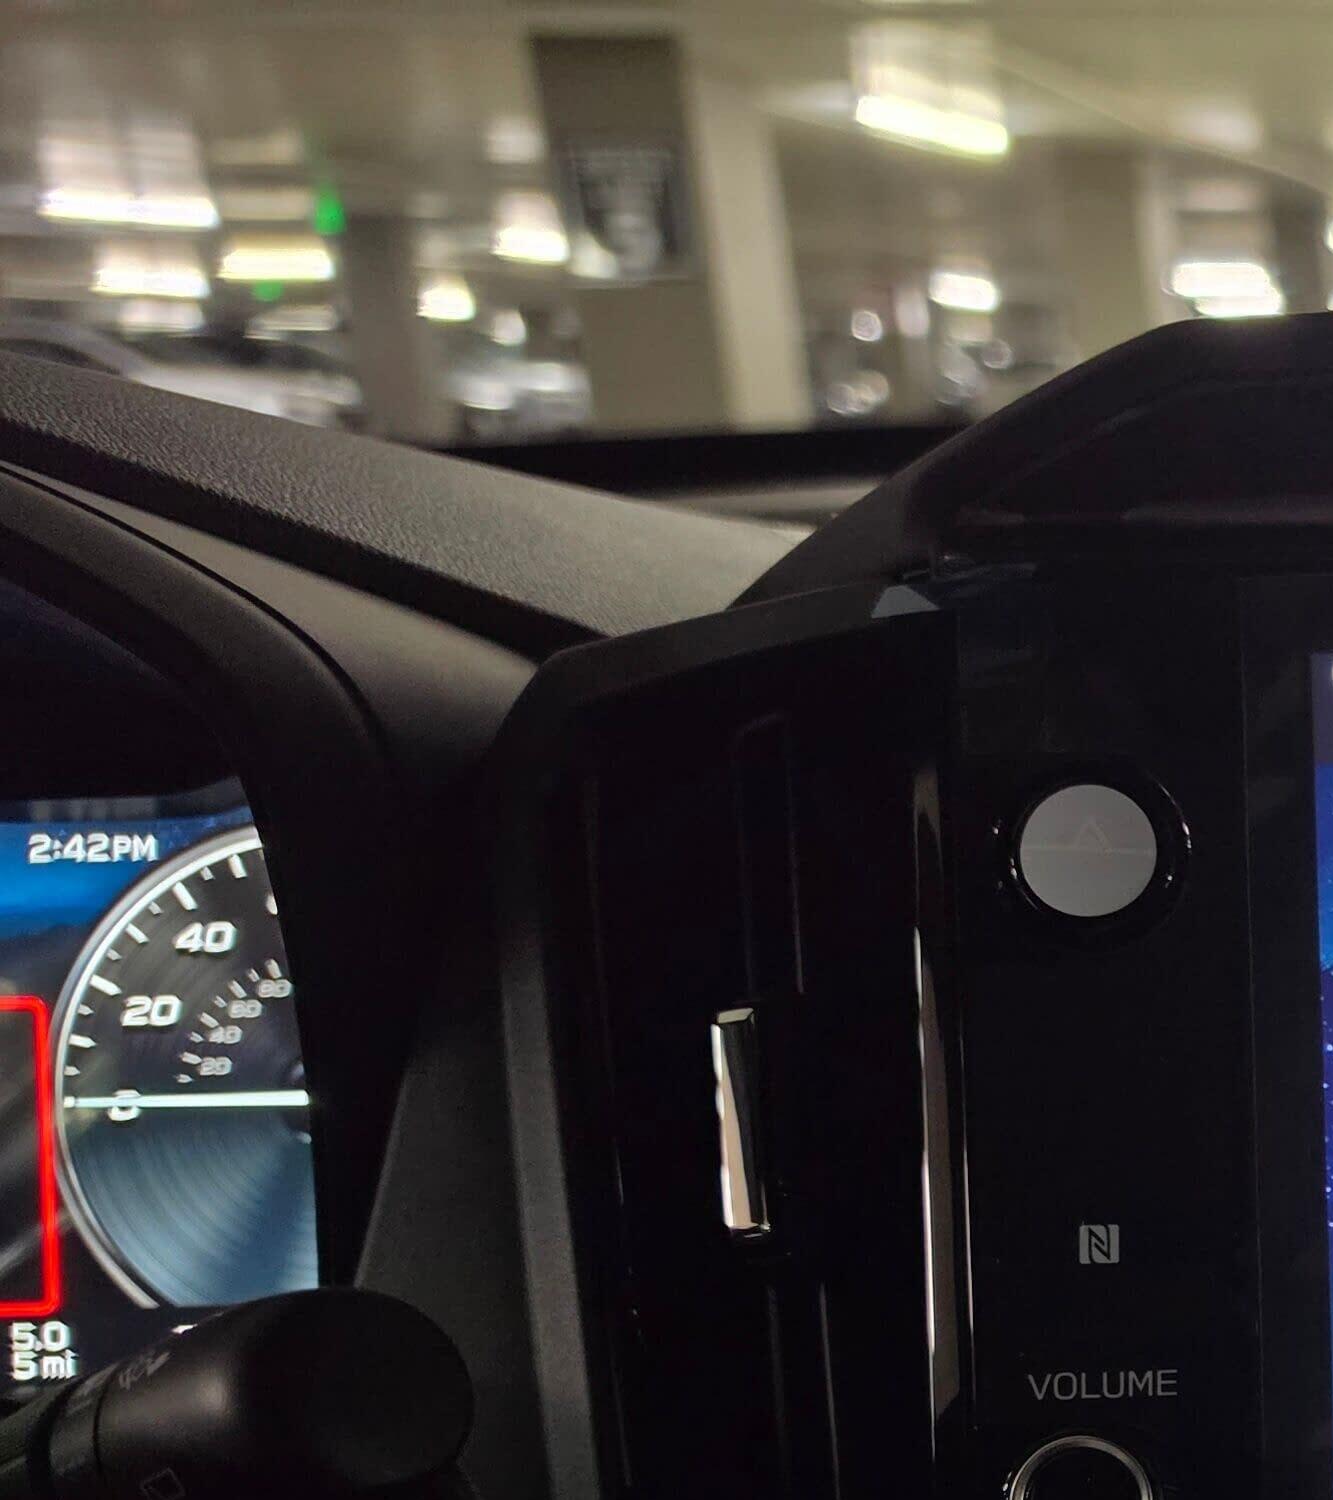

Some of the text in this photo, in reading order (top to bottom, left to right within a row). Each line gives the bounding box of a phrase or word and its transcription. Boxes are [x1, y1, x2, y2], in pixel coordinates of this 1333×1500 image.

[174, 920, 237, 954] 40
[119, 994, 182, 1027] 20
[1027, 1368, 1179, 1401] VOLUME
